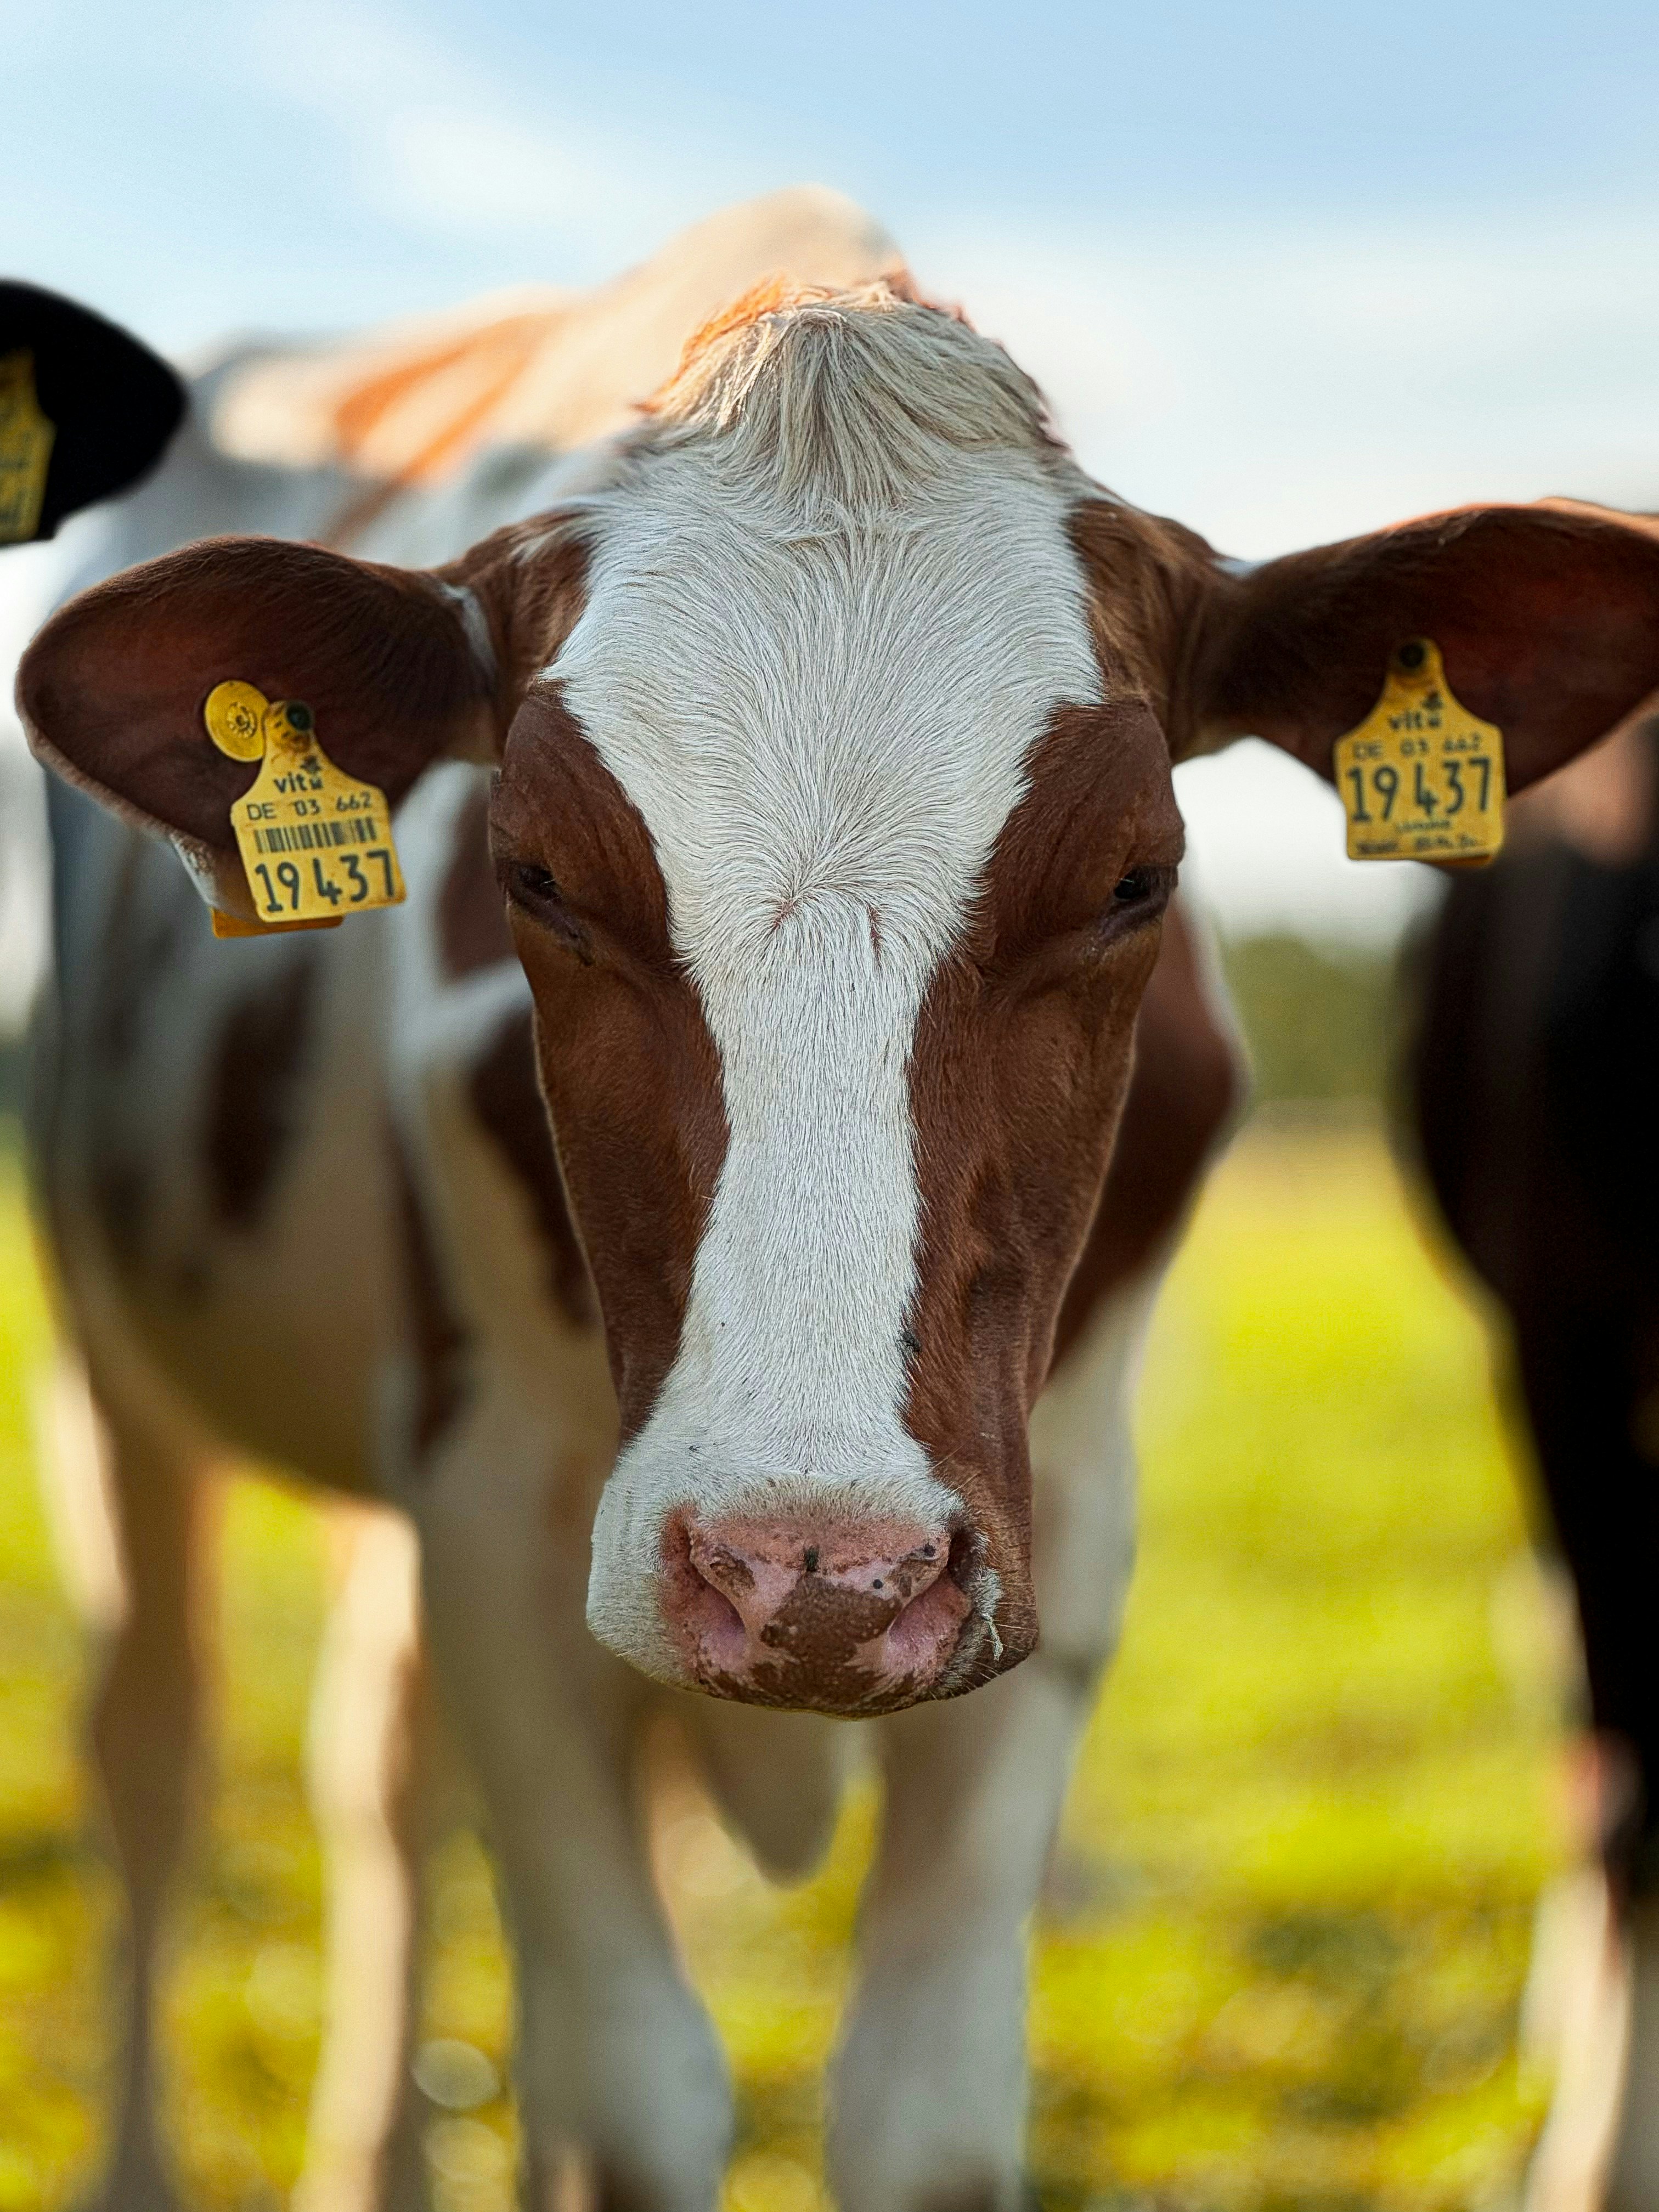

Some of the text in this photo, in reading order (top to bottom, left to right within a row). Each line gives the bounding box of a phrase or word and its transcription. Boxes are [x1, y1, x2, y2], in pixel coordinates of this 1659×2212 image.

[246, 792, 373, 820] DE 03 662
